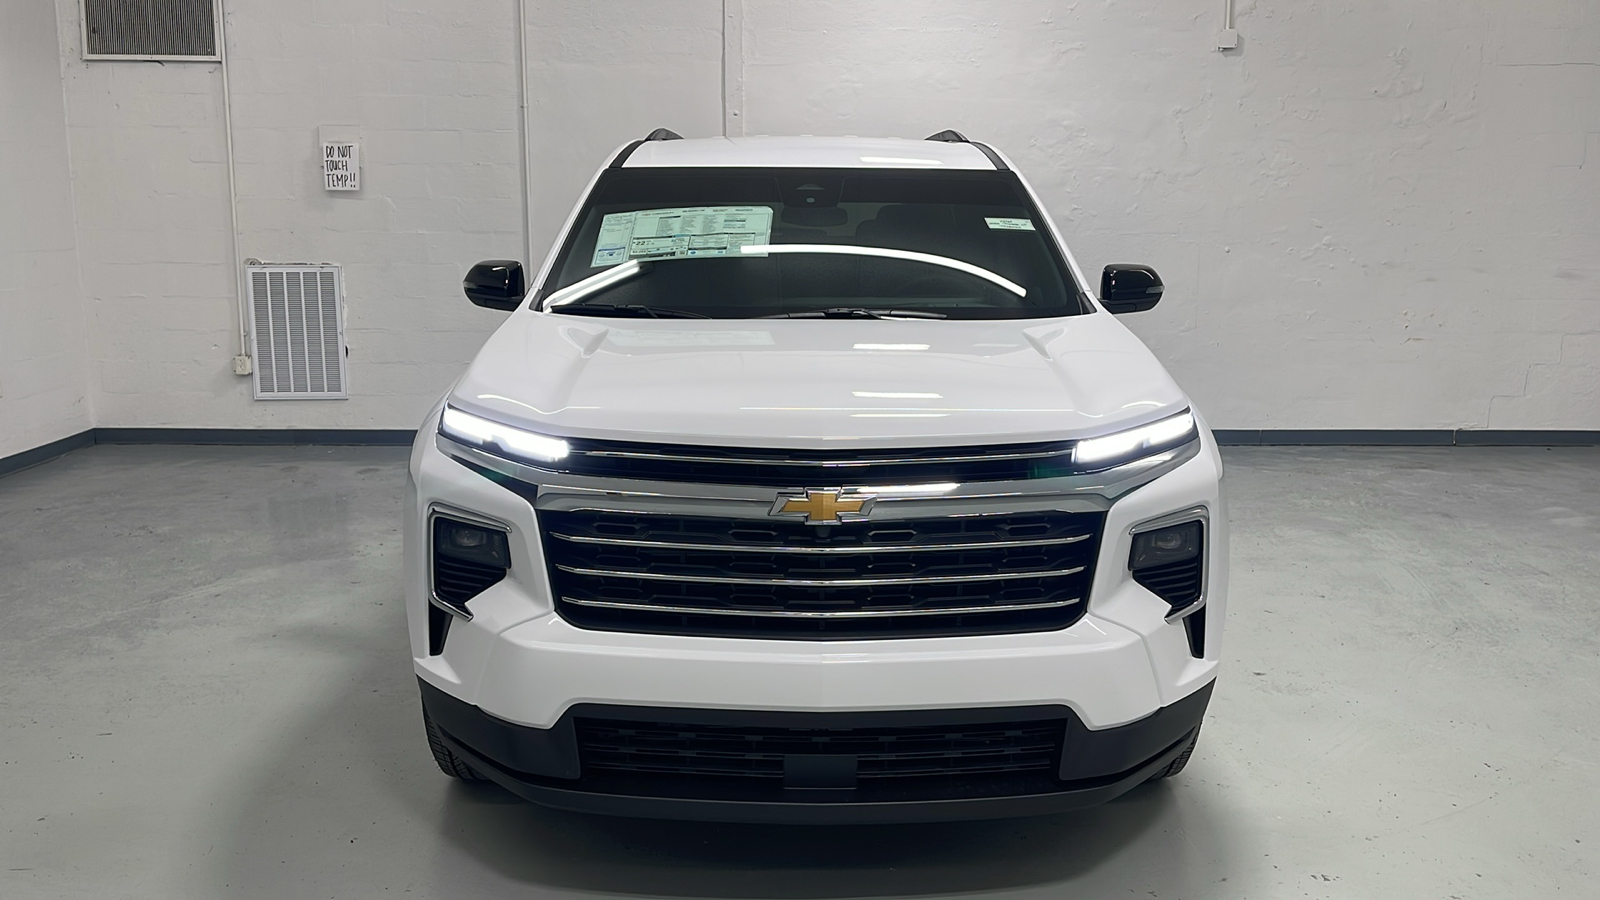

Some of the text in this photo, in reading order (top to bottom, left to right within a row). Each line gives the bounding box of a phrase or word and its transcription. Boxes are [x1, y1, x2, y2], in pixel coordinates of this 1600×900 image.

[325, 144, 354, 159] DO NOT
[325, 159, 349, 172] TOUCH
[326, 172, 356, 188] TEMP!!
